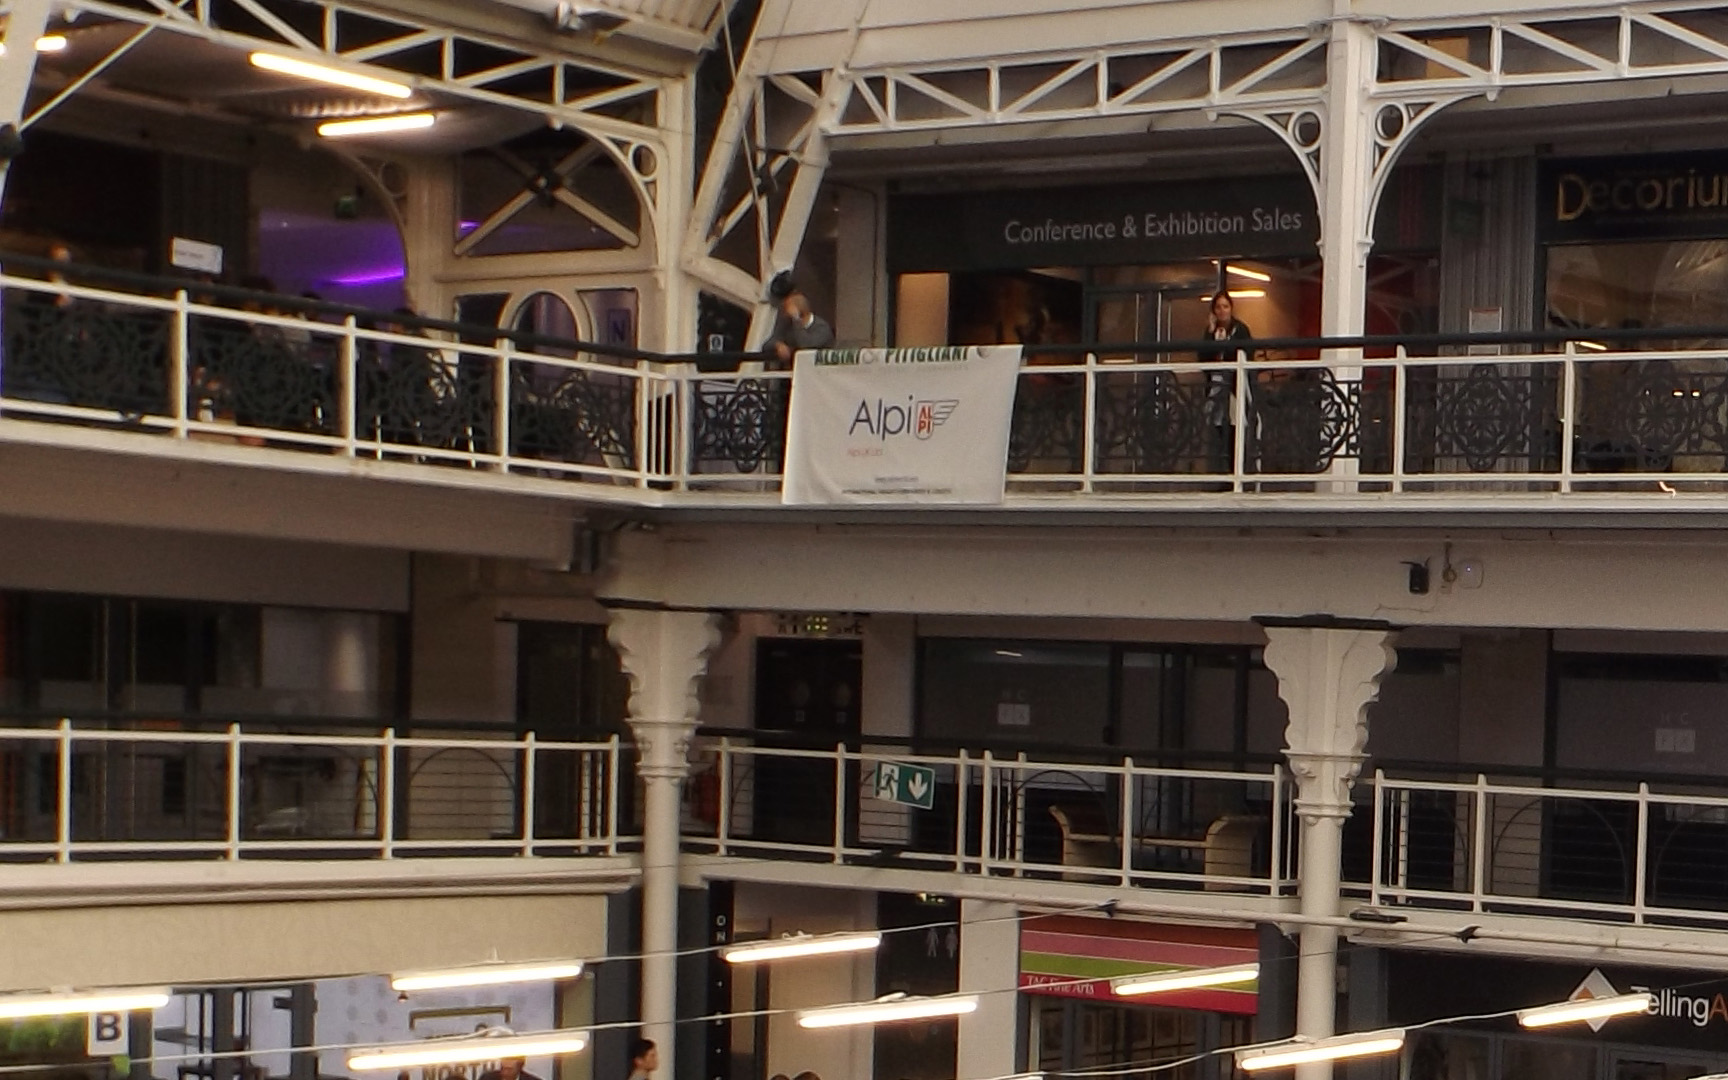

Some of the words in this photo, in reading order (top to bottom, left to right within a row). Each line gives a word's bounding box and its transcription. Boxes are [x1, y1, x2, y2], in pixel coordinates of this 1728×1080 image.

[1004, 219, 1115, 243] Conference
[1122, 214, 1137, 238] &
[1145, 212, 1244, 237] Exhibition
[1252, 208, 1302, 231] Sales
[849, 394, 914, 441] Alpi
[96, 1012, 122, 1041] B
